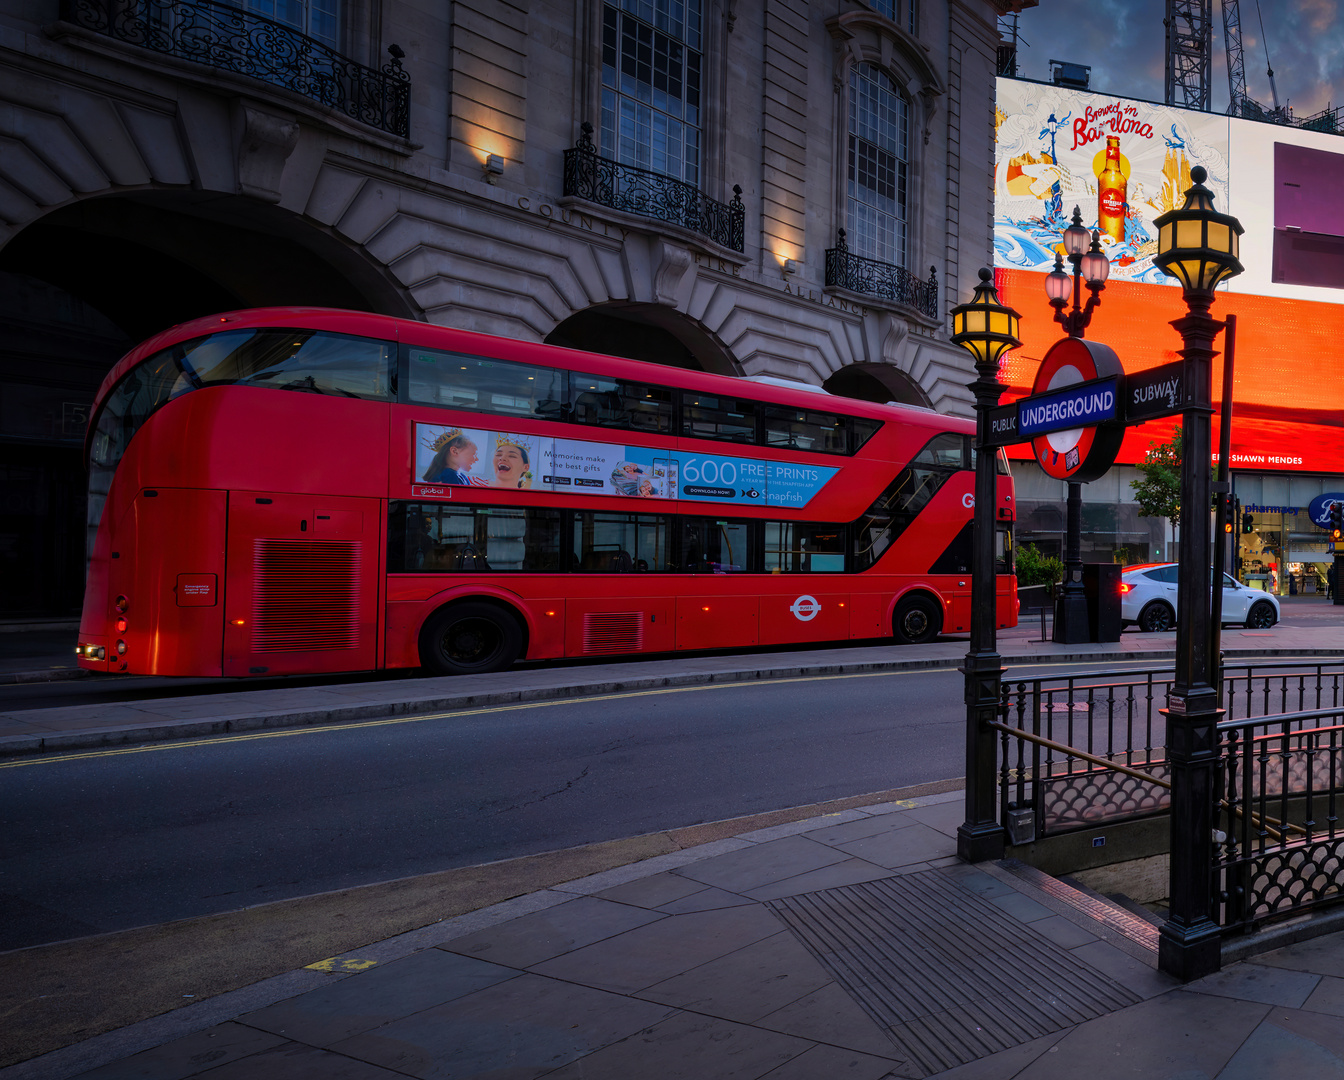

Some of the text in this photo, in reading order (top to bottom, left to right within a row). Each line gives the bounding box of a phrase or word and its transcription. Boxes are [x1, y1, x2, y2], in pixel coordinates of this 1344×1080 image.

[1085, 101, 1138, 123] Brewed in
[517, 196, 741, 277] COUNTY FIRE
[783, 282, 935, 339] ALLIANCE IFE
[1133, 377, 1180, 405] SUBWAY
[1021, 390, 1114, 427] UNDERGROUND
[992, 416, 1016, 433] PUBLIC
[543, 450, 606, 464] Memories make
[1268, 456, 1303, 465] MENDES
[549, 461, 601, 473] the best gifts
[682, 458, 818, 485] 600 FREE PRINTS
[761, 488, 803, 504] Snapfish
[1244, 502, 1300, 517] pharmacy
